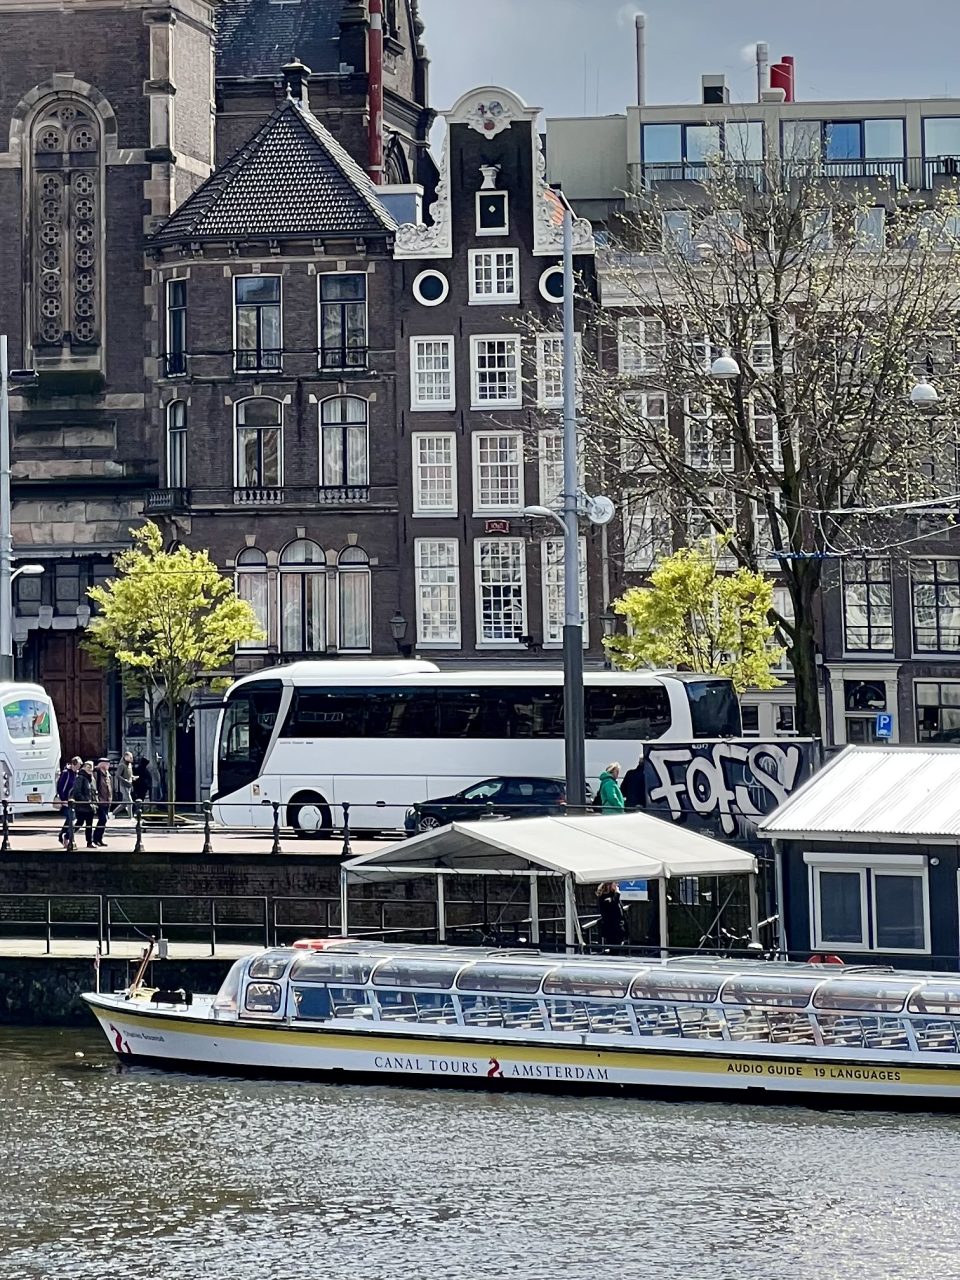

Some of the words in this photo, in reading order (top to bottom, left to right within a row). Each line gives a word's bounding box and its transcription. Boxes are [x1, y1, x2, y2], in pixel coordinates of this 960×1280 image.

[880, 715, 890, 728] P
[374, 1056, 423, 1070] CANAL
[428, 1059, 478, 1074] TOURS
[511, 1063, 609, 1081] AMSTERDAM
[727, 1063, 763, 1074] AUDIO
[767, 1065, 802, 1076] GUIDE
[814, 1067, 826, 1077] 19
[830, 1068, 901, 1081] LANGUAGES
